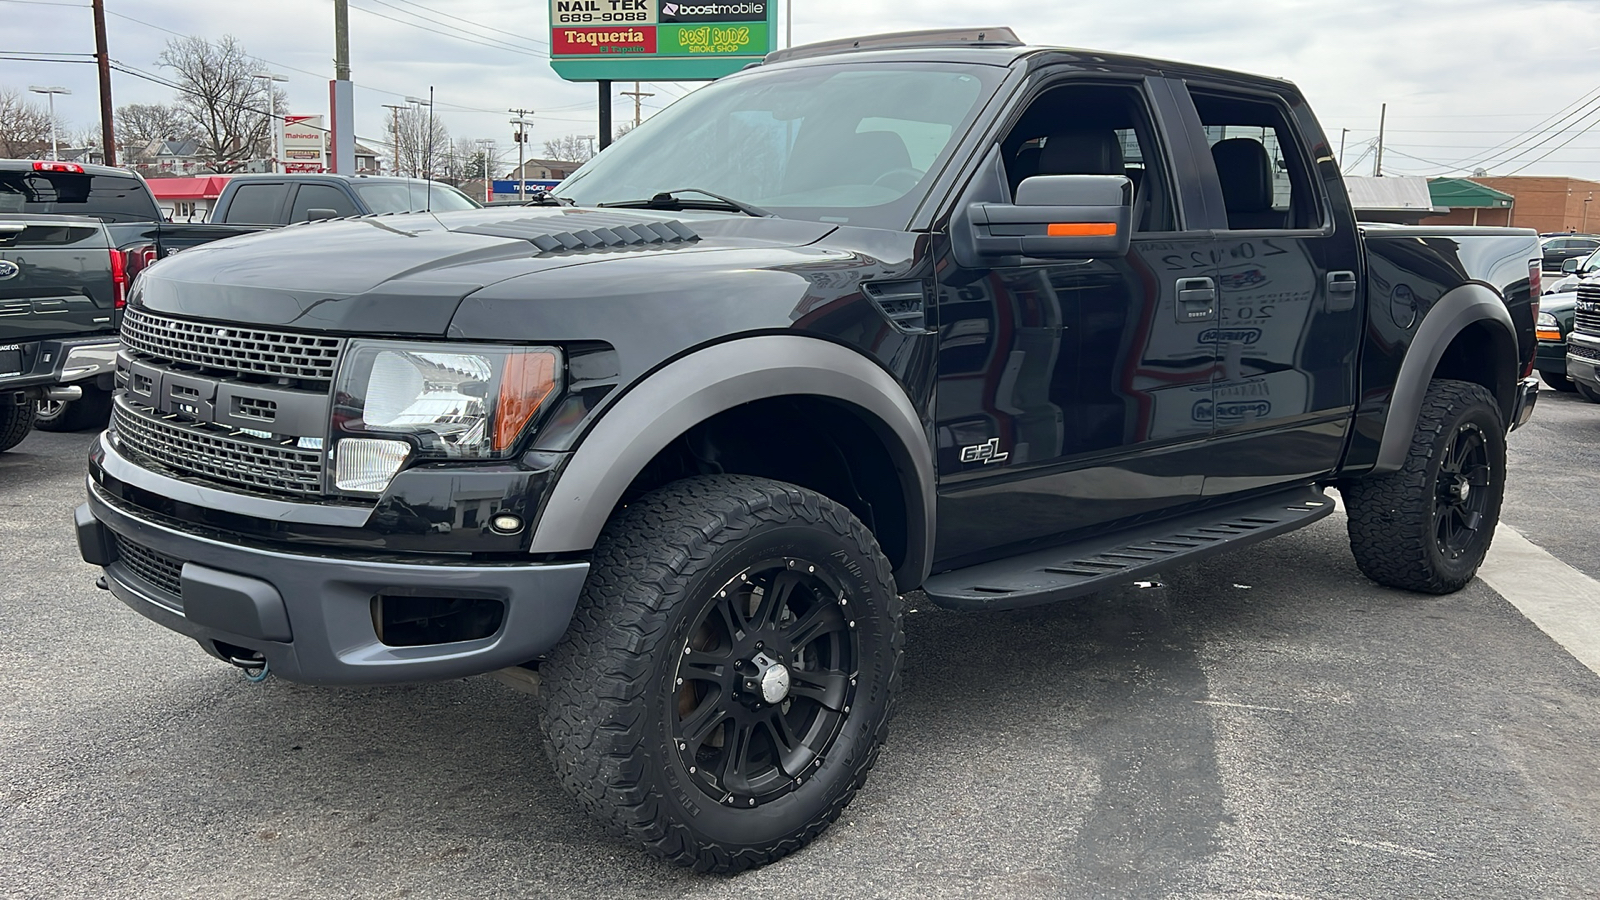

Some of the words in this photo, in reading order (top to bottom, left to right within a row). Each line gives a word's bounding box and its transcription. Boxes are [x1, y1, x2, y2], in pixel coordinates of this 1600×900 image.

[558, 1, 600, 12] NAIL
[608, 0, 648, 11] TEK
[560, 12, 647, 22] 689-9088
[564, 28, 644, 46] Taquería
[688, 45, 715, 53] SMOKE
[716, 45, 739, 53] SHOP
